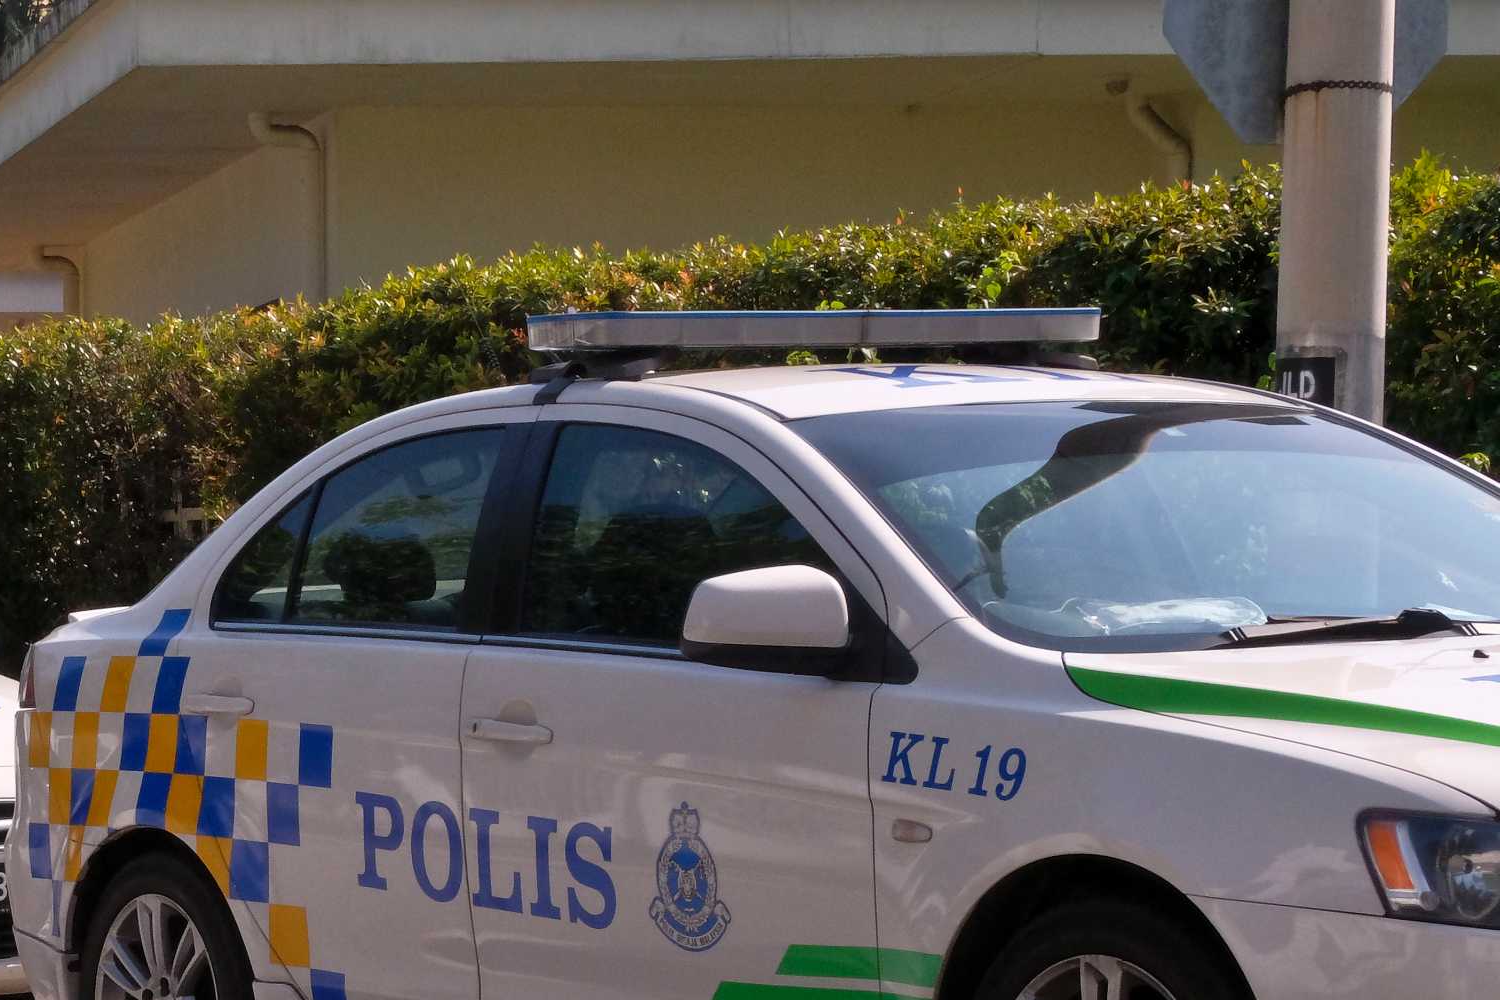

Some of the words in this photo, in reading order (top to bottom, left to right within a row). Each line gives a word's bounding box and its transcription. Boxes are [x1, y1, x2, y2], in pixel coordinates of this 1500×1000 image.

[881, 731, 956, 791] KL
[967, 744, 1027, 801] 19
[355, 791, 618, 930] POLIS
